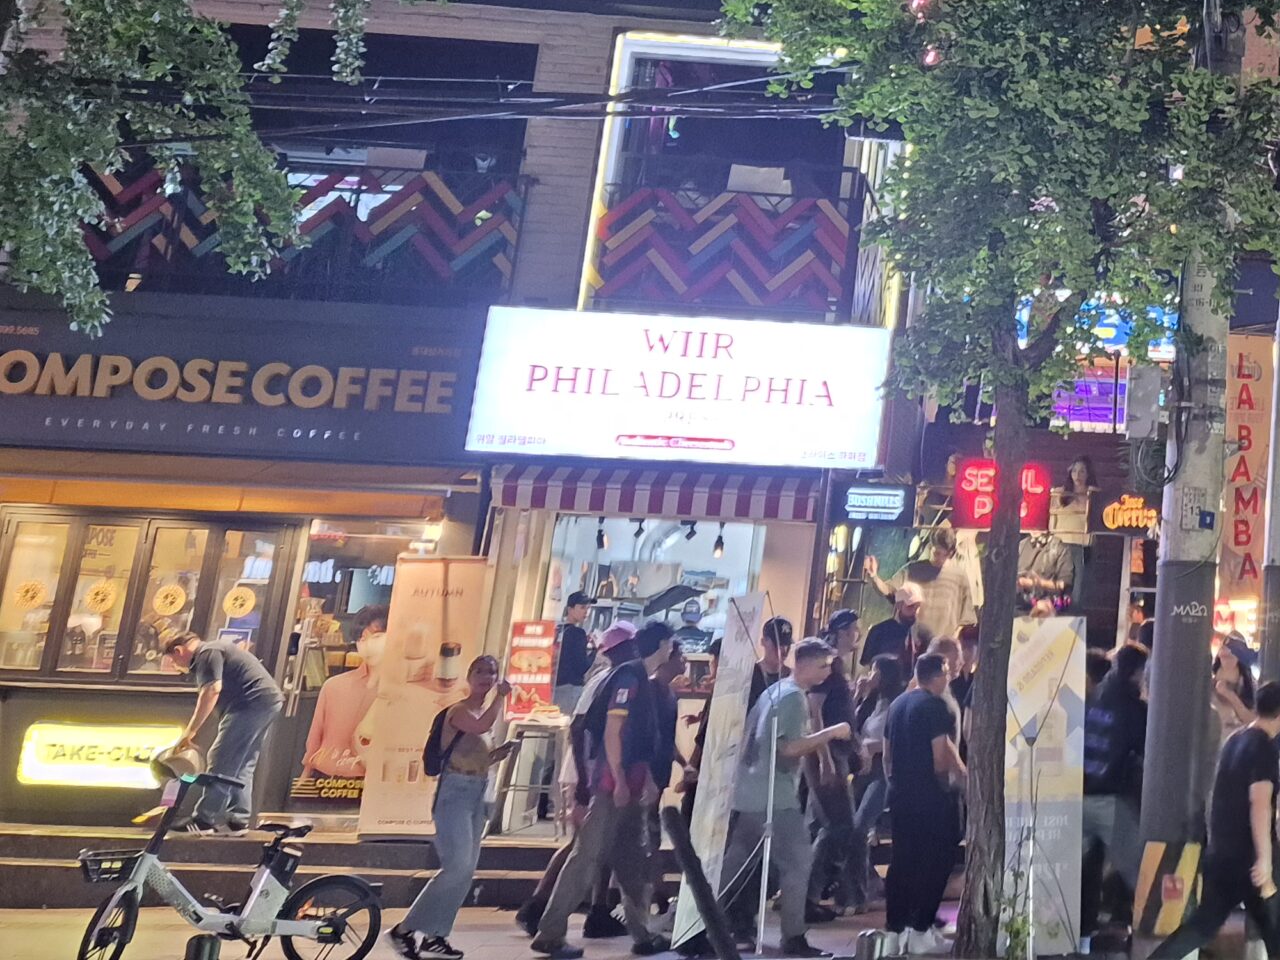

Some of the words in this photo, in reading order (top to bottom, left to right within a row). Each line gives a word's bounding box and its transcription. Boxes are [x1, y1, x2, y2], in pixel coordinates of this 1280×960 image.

[251, 362, 458, 414] COFFEE
[525, 364, 834, 408] PHILADELPHIA
[1237, 352, 1255, 411] LA
[45, 417, 168, 432] EVERYDAY
[187, 424, 258, 436] FRESH
[277, 428, 362, 441] COFFEE
[1230, 424, 1260, 581] BAMBA
